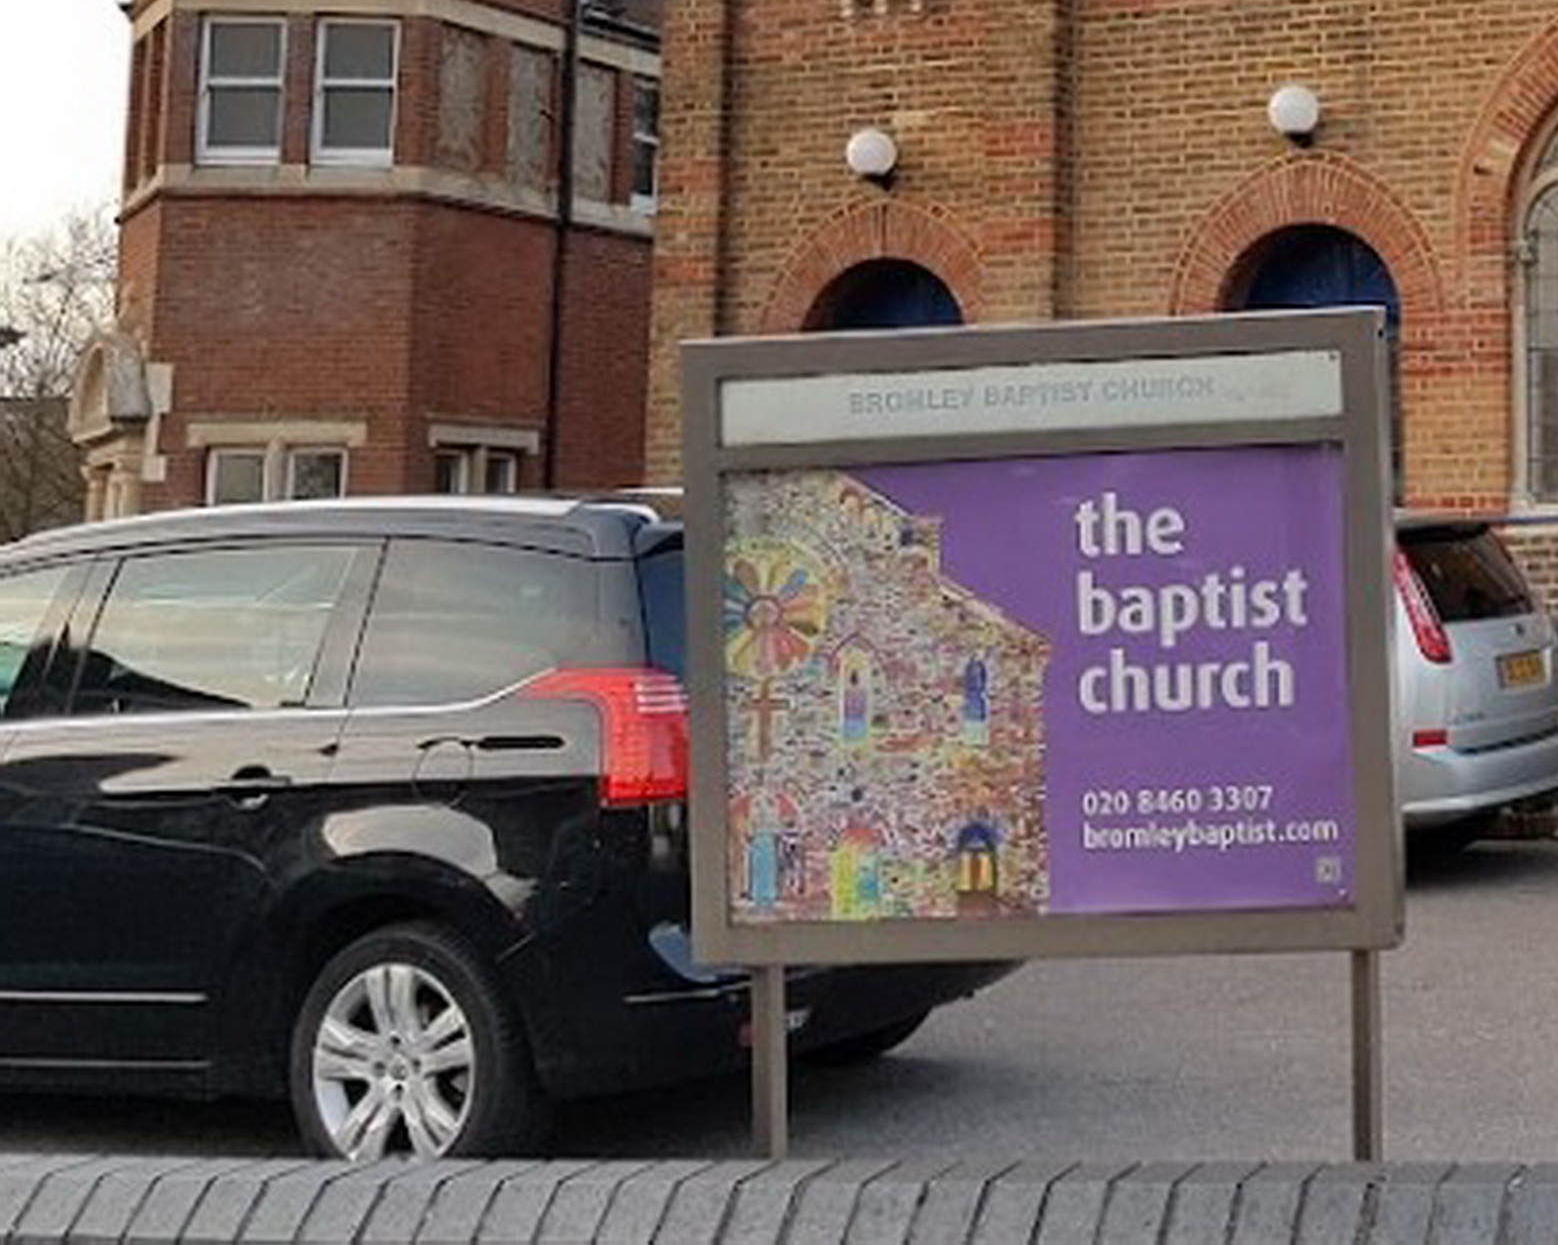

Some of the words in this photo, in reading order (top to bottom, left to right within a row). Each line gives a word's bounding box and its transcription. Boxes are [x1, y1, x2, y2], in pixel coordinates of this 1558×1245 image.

[850, 388, 974, 415] BROMLEY
[984, 381, 1092, 407] BAPTIST
[1075, 492, 1185, 557] the
[1077, 565, 1308, 647] baptist
[1079, 641, 1294, 715] church
[1083, 791, 1128, 815] 020
[1136, 789, 1202, 813] 8460
[1209, 785, 1272, 811] 3307
[1083, 818, 1339, 852] bromleybaptist.com
